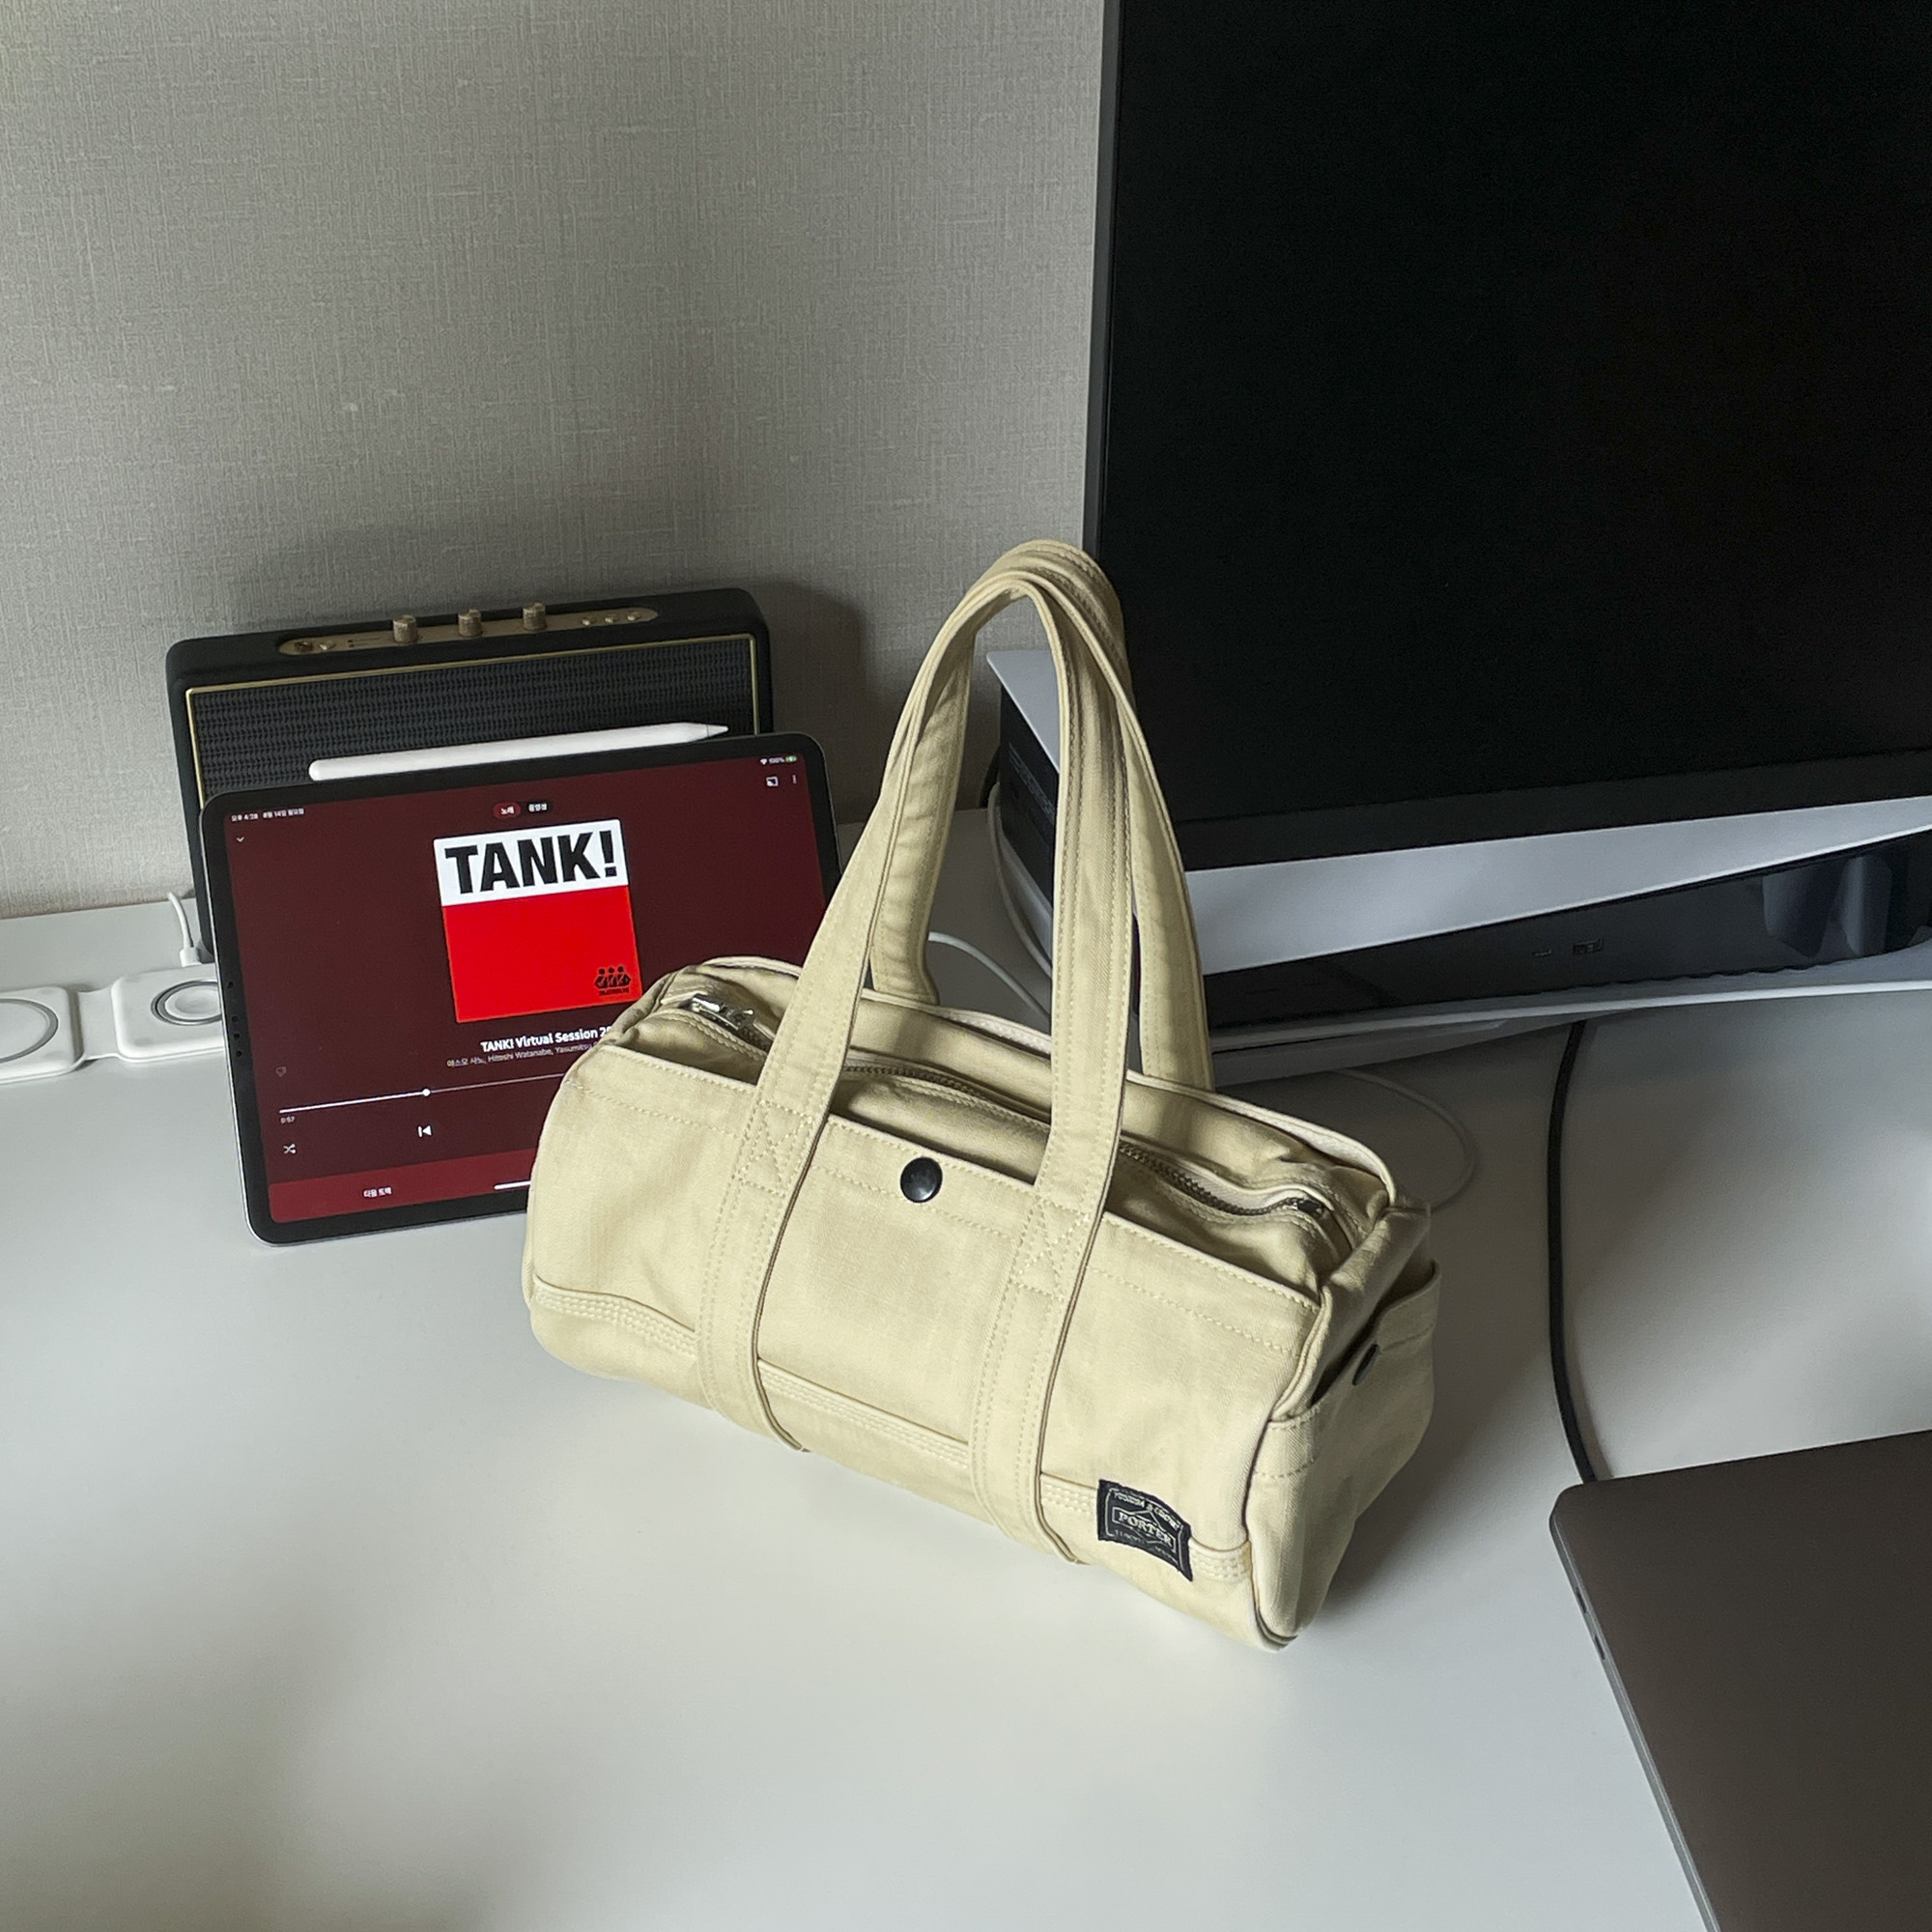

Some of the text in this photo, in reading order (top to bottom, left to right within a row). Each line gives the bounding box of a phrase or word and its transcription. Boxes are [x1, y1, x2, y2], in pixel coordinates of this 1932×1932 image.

[444, 830, 618, 895] TANK!
[480, 1039, 515, 1053] TANK!
[515, 1033, 554, 1048] Virtual
[554, 1028, 598, 1043] Session
[1118, 1511, 1174, 1548] PORTER
